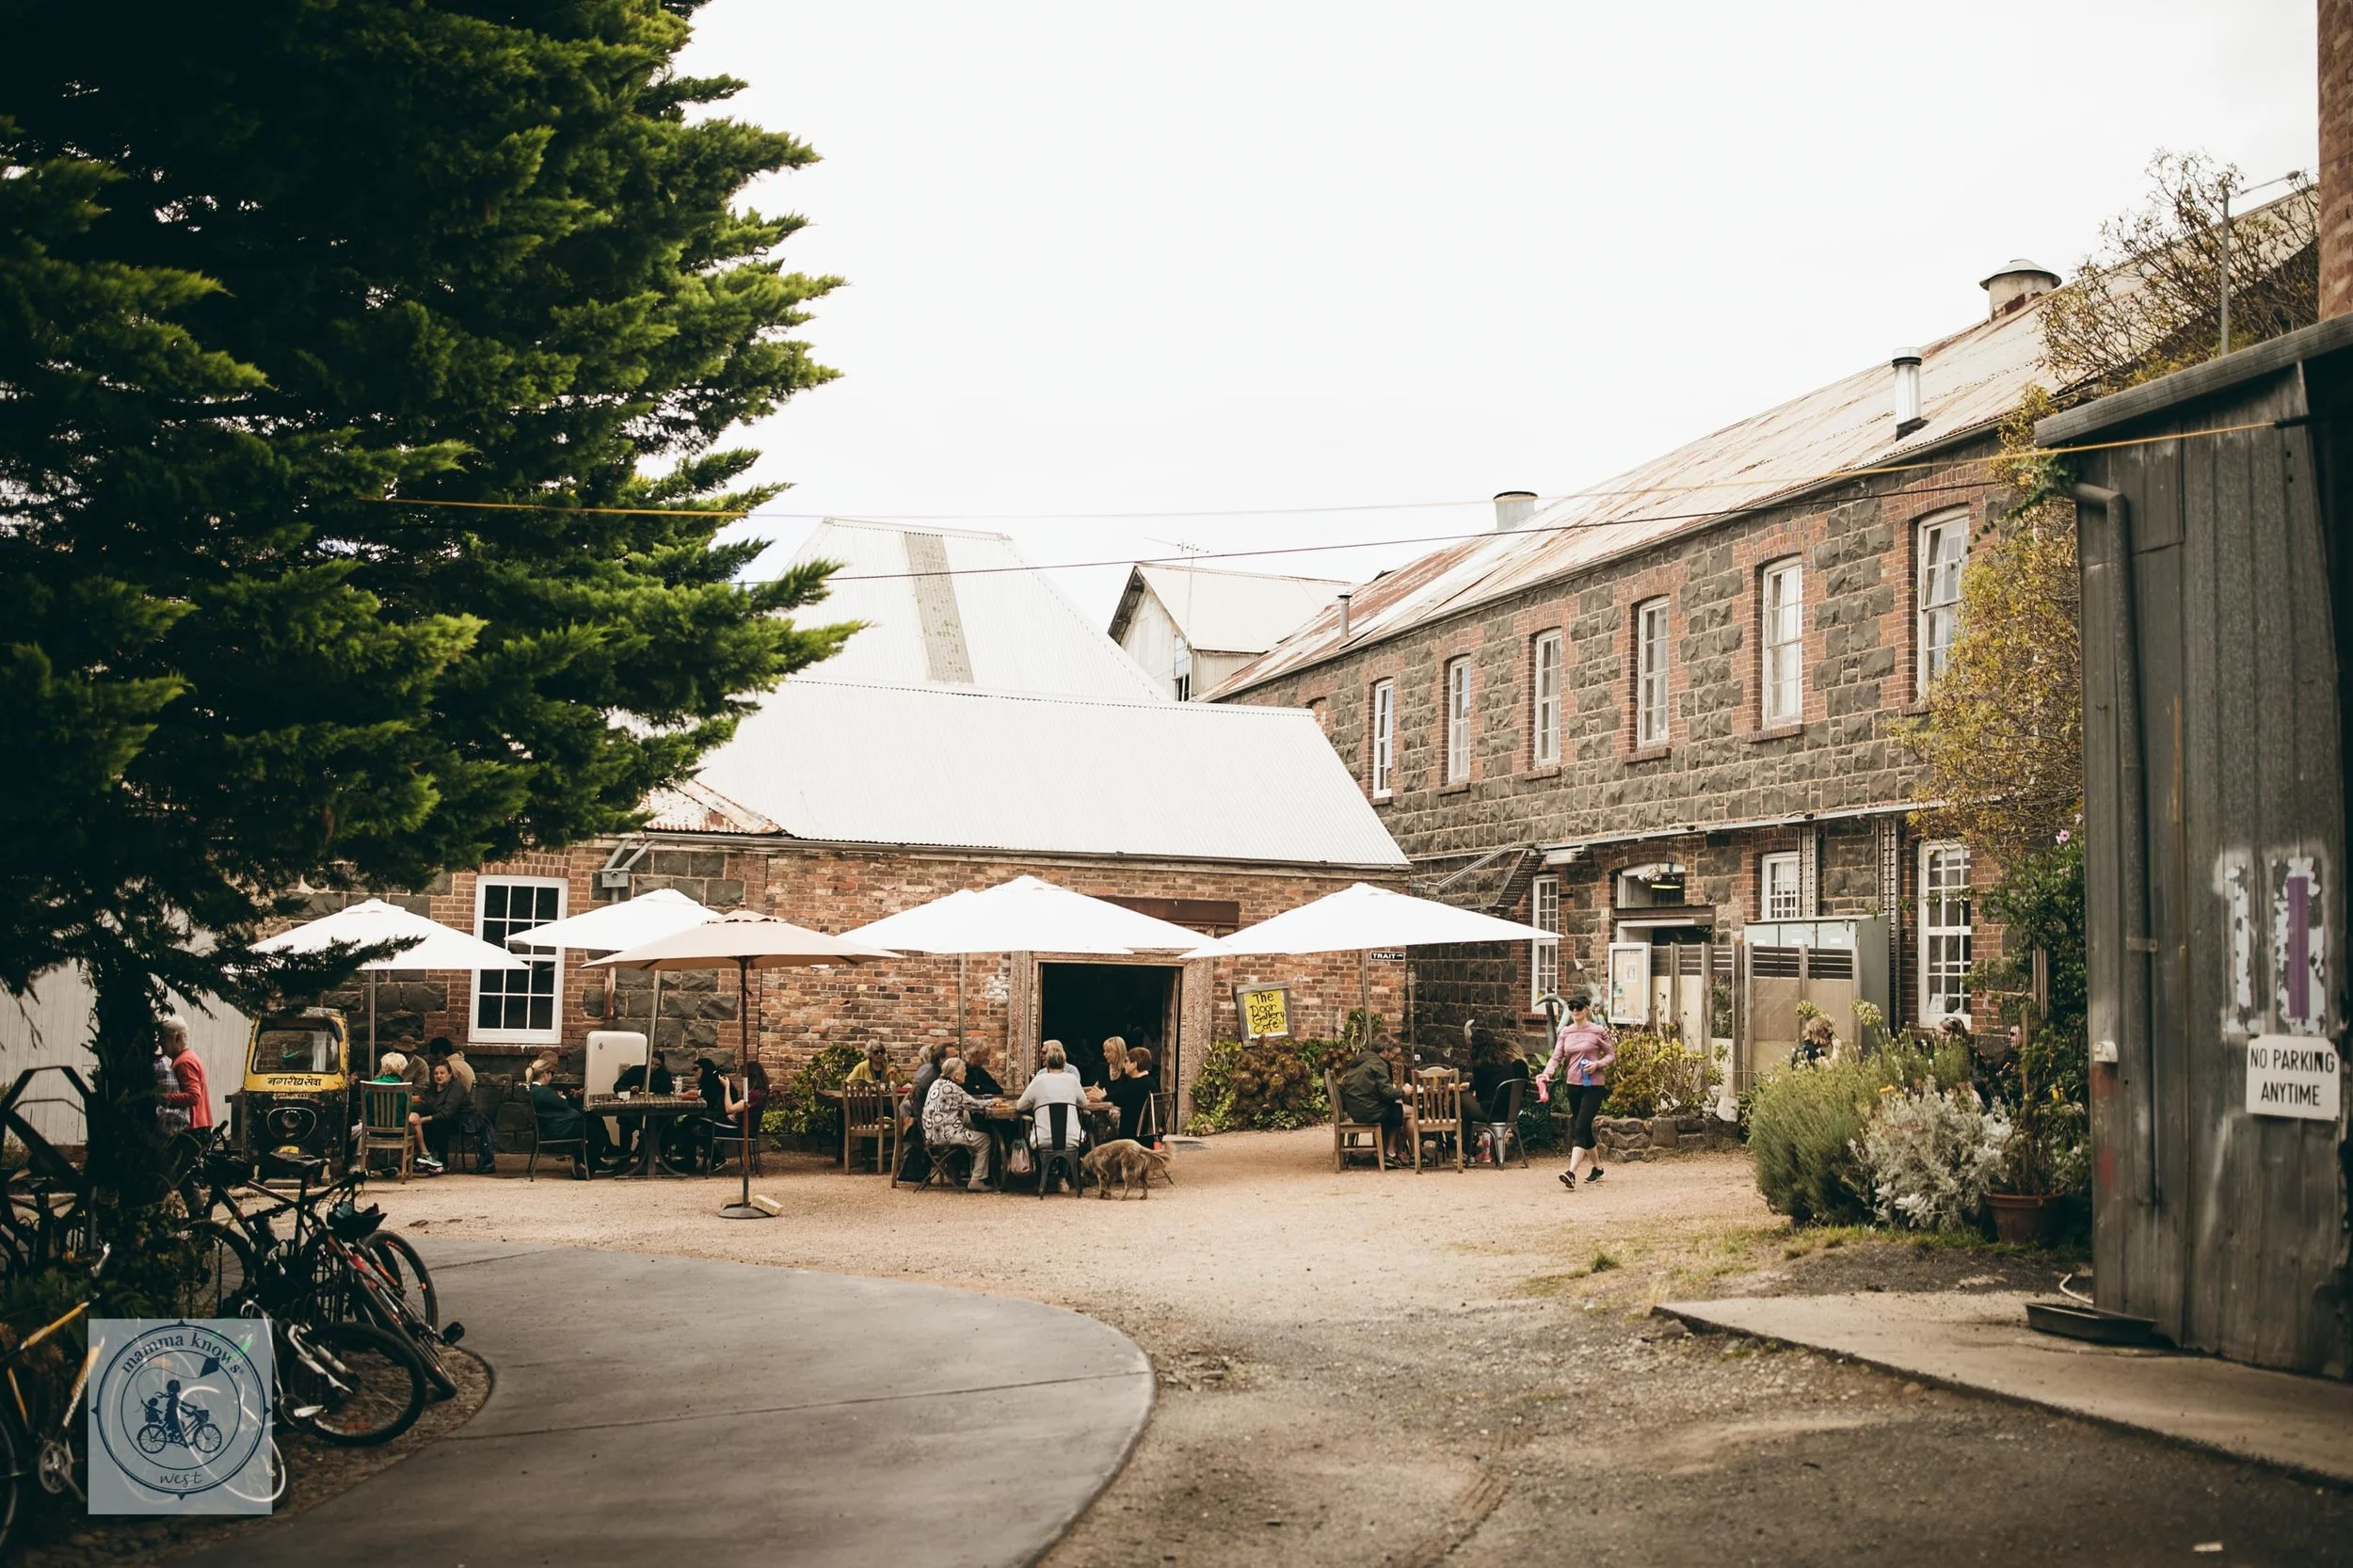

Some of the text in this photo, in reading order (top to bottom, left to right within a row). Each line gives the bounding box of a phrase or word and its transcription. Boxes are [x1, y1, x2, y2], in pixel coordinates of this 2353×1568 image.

[1252, 991, 1274, 1004] The
[1250, 1004, 1277, 1017] Door
[1253, 1011, 1285, 1025] Gallery
[2250, 1048, 2335, 1073] NO PARKING
[2261, 1080, 2320, 1106] ANYTIME
